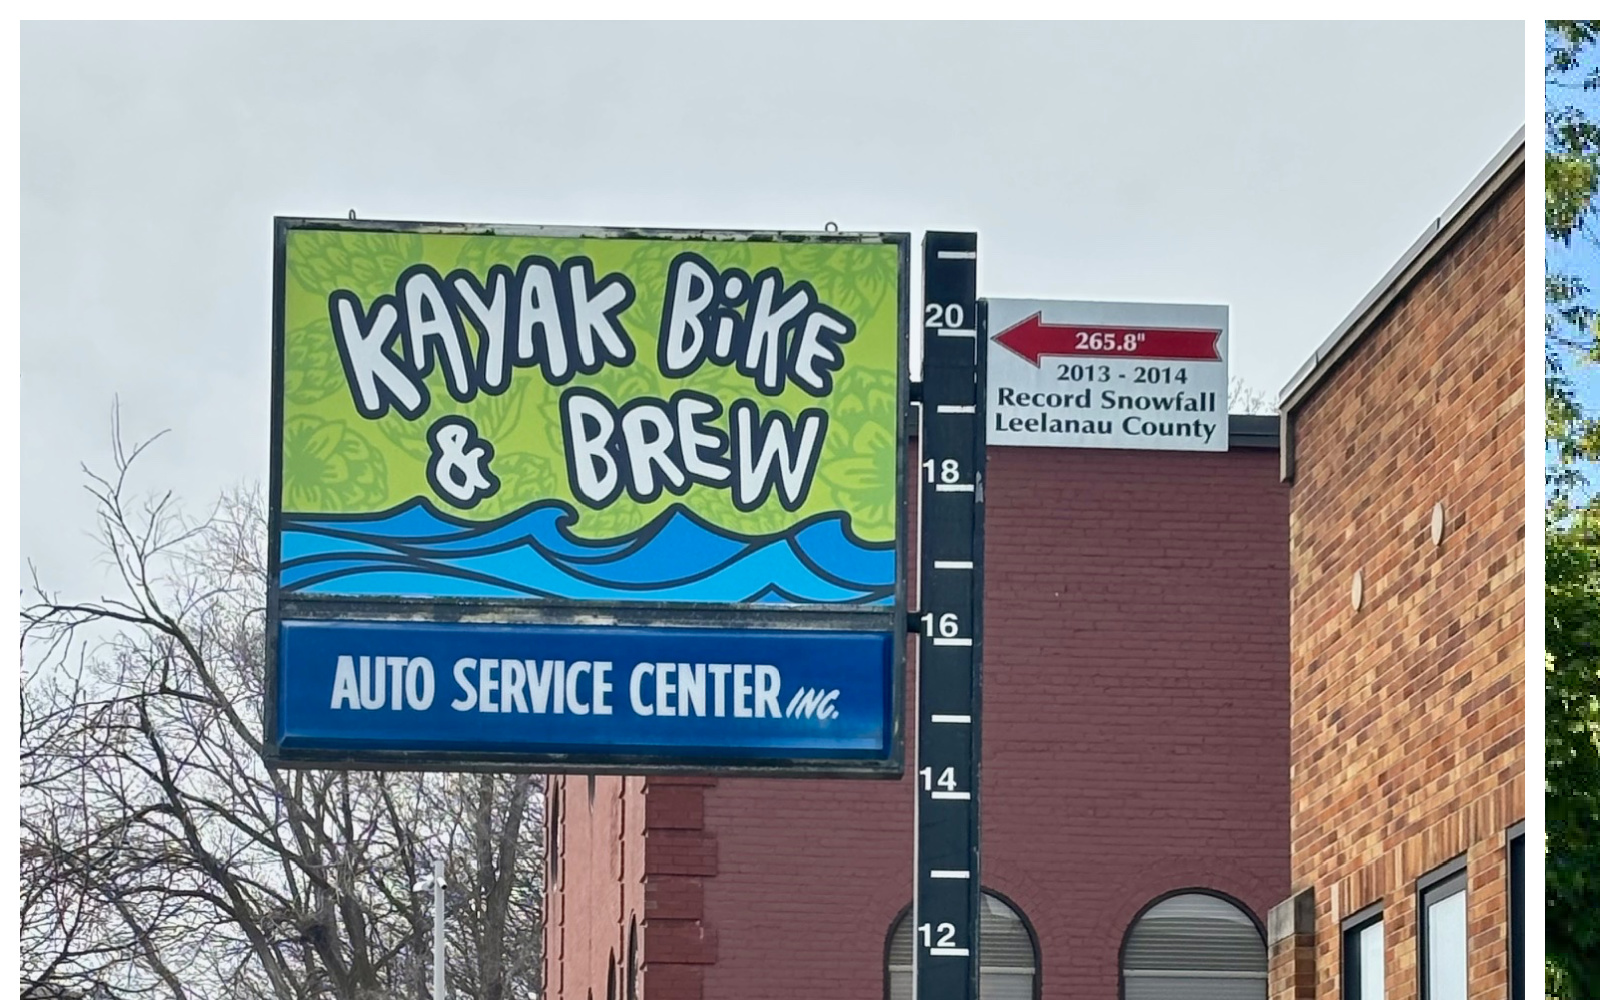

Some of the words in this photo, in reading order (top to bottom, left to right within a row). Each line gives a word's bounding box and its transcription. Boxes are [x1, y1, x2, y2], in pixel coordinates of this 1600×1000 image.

[924, 303, 964, 328] 20
[336, 263, 629, 412] KAYAK
[1074, 331, 1146, 351] 265.8"
[1056, 364, 1111, 383] 2013
[1133, 366, 1188, 385] 2014
[998, 387, 1091, 409] Record
[1100, 389, 1216, 413] Snowfall
[994, 412, 1113, 436] Leelanau
[1121, 415, 1217, 445] County
[434, 423, 493, 501] &
[566, 394, 821, 504] BREW
[922, 458, 960, 484] 18
[920, 612, 959, 638] 16
[330, 654, 436, 712] AUTO
[450, 657, 614, 716] SERVICE
[629, 660, 783, 719] CENTER
[785, 686, 841, 721] INC.
[919, 766, 957, 792] 14
[917, 922, 956, 948] 12
